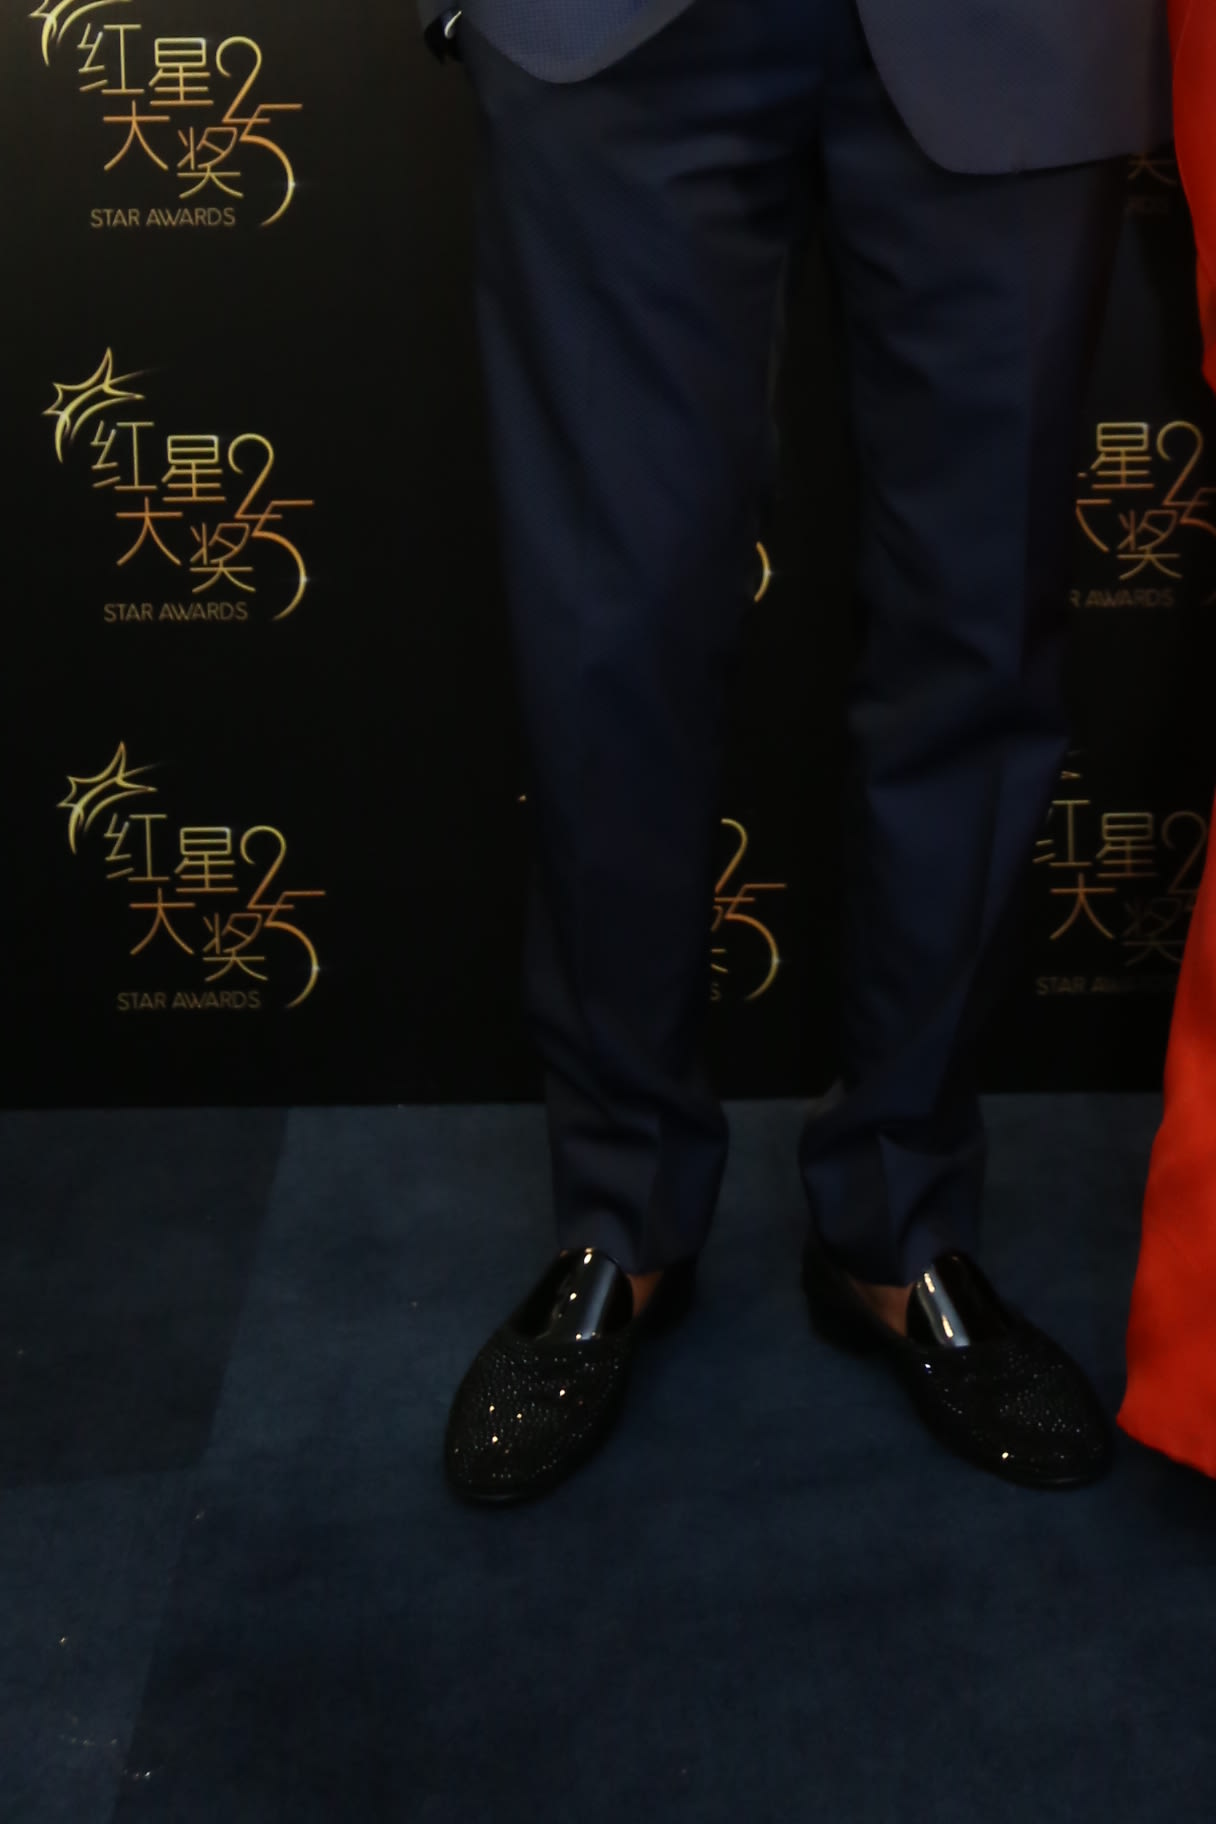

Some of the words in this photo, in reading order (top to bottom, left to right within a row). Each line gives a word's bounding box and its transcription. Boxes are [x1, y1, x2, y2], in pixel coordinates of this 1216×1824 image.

[77, 23, 214, 106] 红星
[103, 100, 244, 199] 大奖
[90, 208, 140, 227] STAR
[146, 207, 236, 227] AWARDS
[90, 420, 226, 502] 红星
[1077, 422, 1154, 489] 星
[116, 496, 256, 594] 大奖
[103, 603, 153, 622] STAR
[159, 601, 249, 622] AWARDS
[104, 813, 239, 893] 红星
[1161, 811, 1209, 911] 2
[129, 887, 268, 982] 大奖
[117, 992, 166, 1011] STAR
[172, 990, 262, 1010] AWARDS
